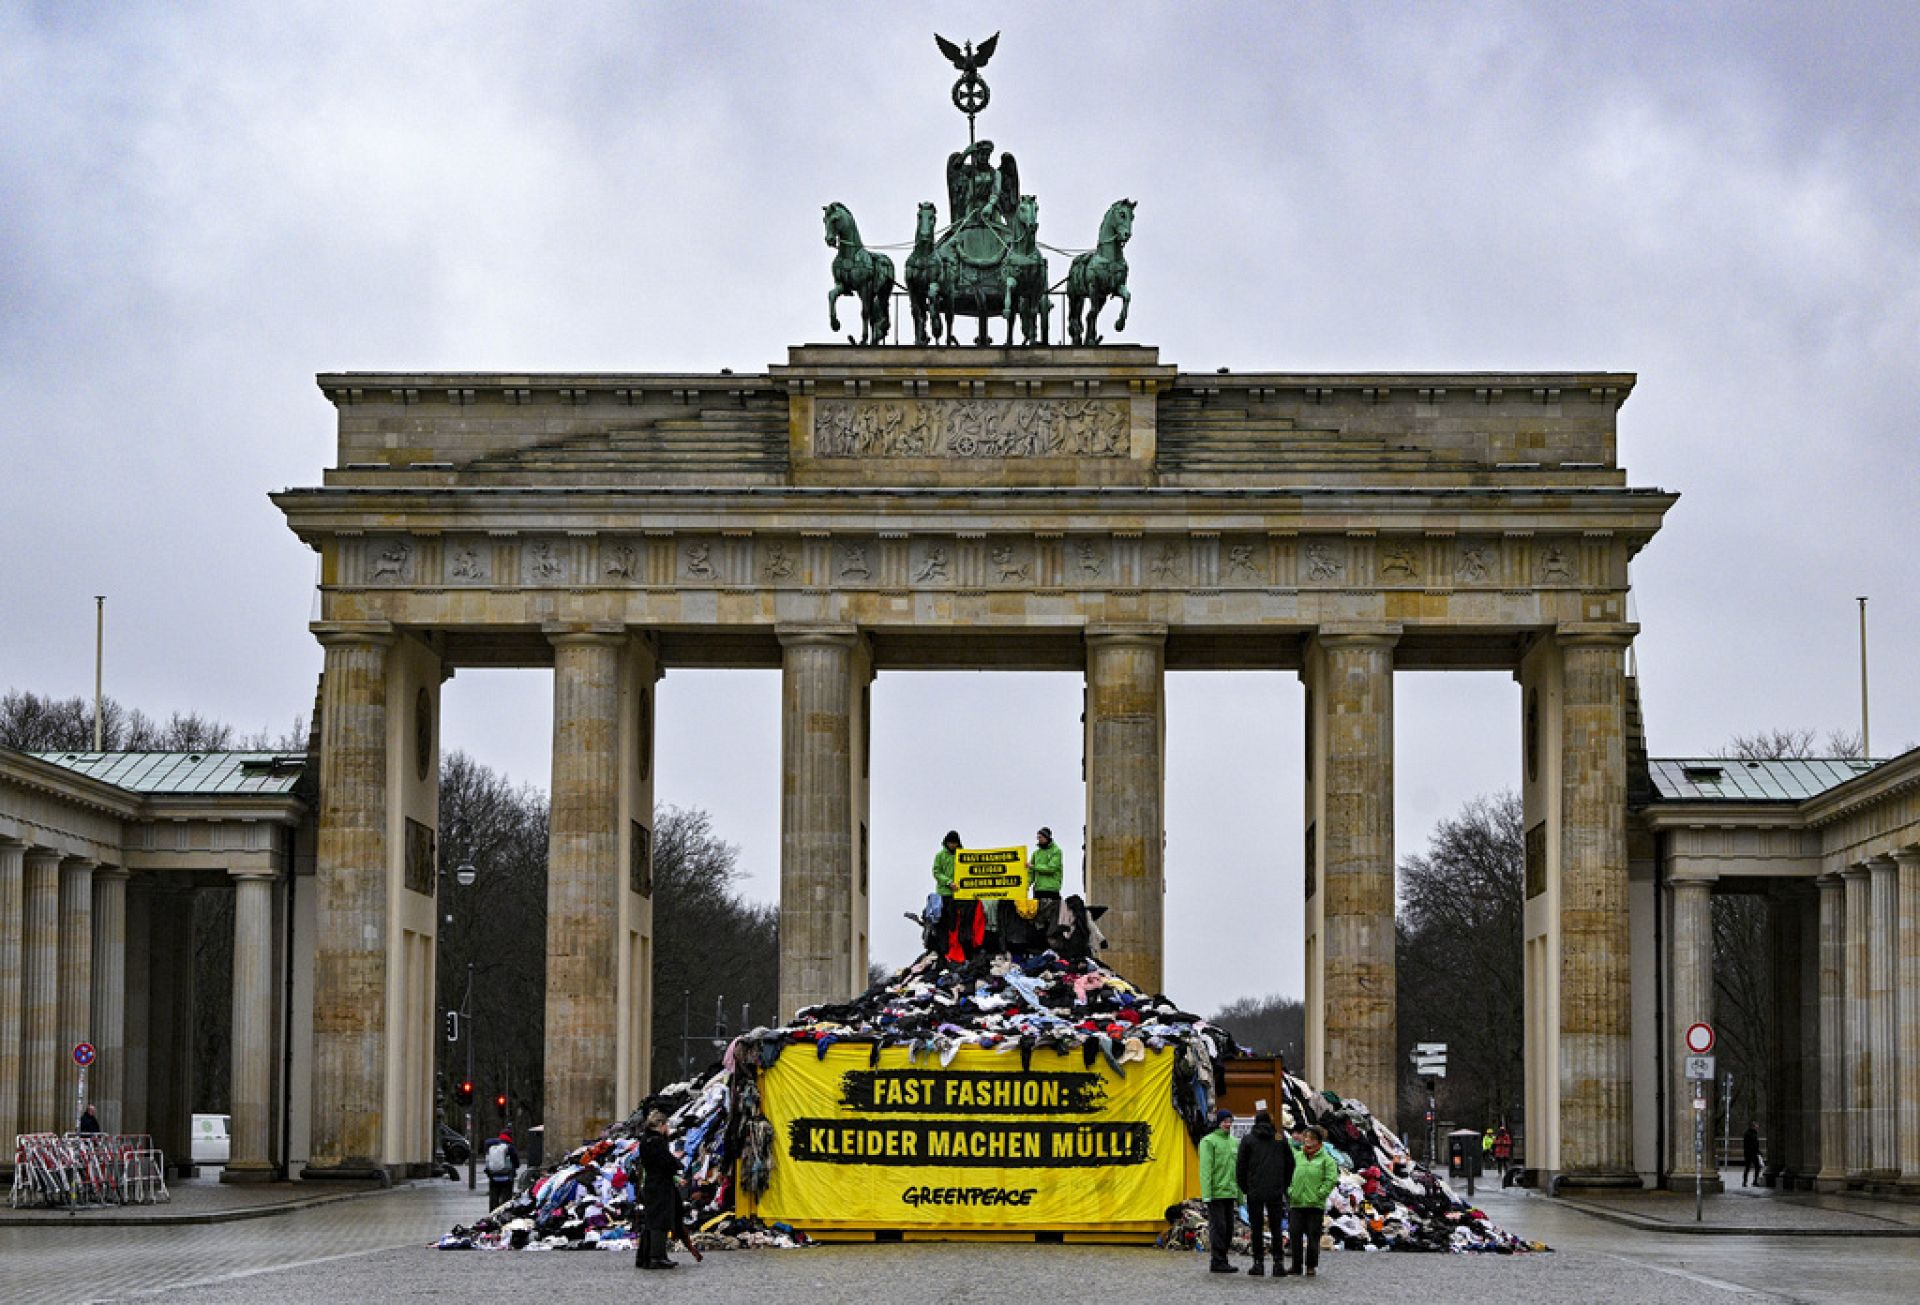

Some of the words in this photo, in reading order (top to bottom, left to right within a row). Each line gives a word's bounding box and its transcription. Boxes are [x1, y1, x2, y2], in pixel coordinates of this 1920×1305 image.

[873, 1079, 935, 1105] FAST
[946, 1079, 1069, 1106] FASHION:
[809, 1128, 918, 1156] KLEIDER
[927, 1131, 1040, 1158] MACHEN
[1051, 1126, 1132, 1158] MÜLL!
[902, 1186, 1038, 1207] GREENPEACE
